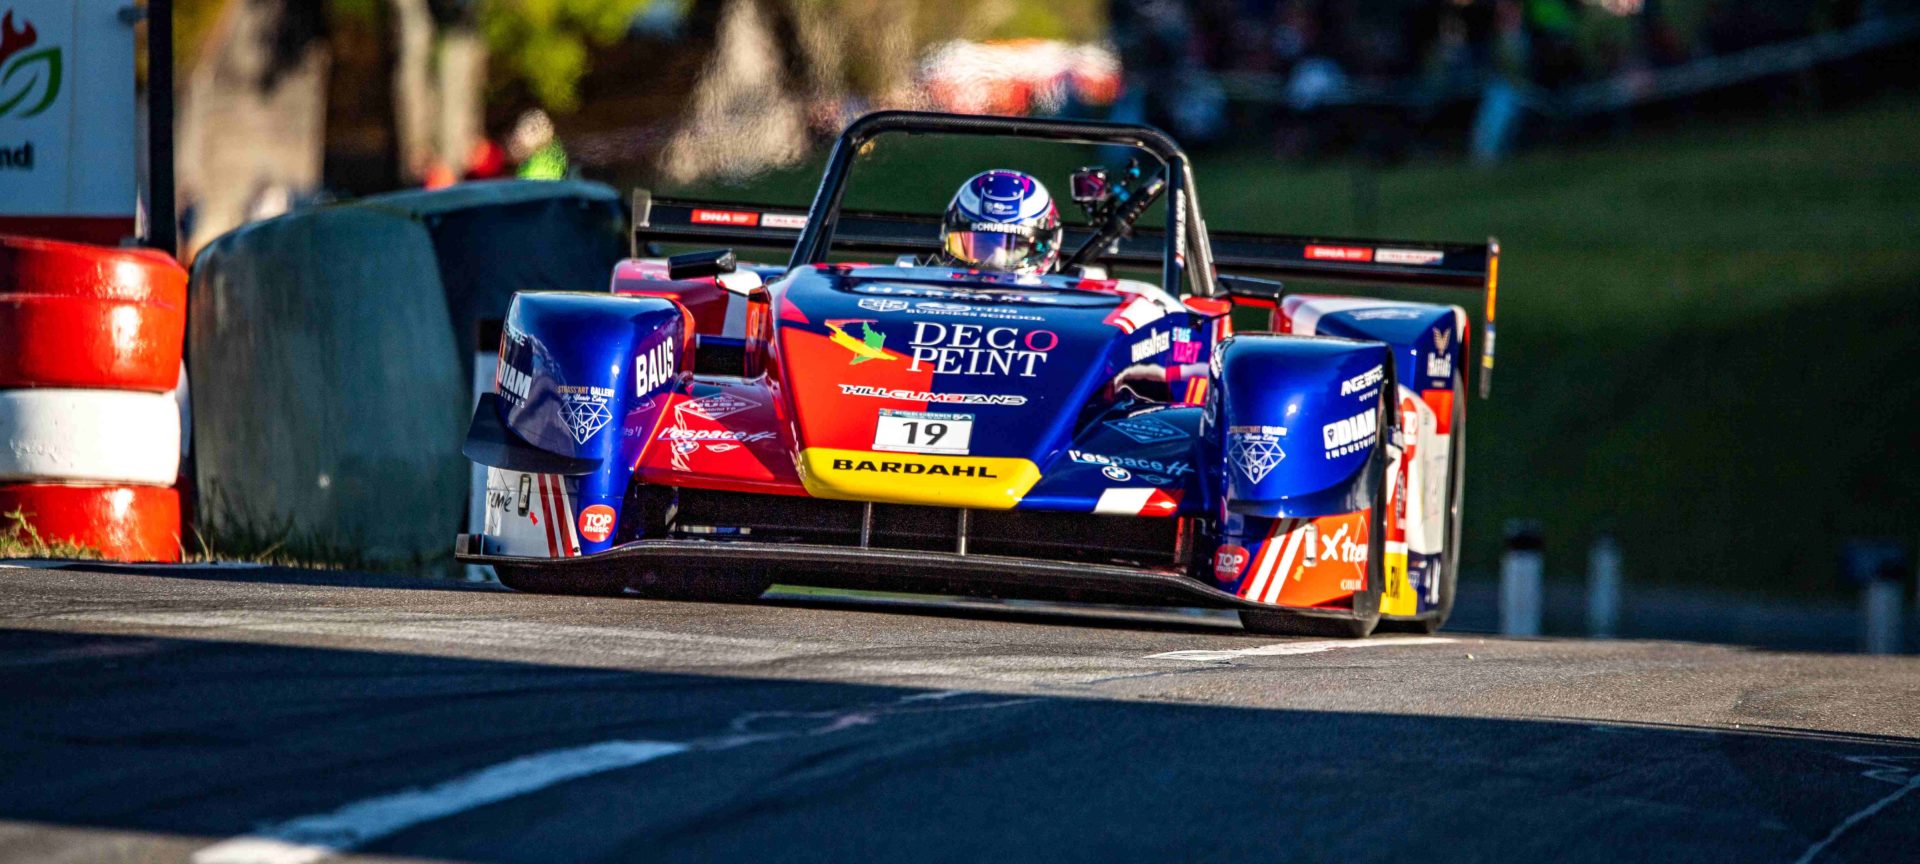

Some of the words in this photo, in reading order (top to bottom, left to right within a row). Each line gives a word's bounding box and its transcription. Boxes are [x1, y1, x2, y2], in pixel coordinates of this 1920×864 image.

[979, 312, 1046, 322] SCHOOL
[908, 321, 1059, 352] DECO
[636, 335, 674, 398] BAUS
[906, 346, 1047, 377] PEINT
[902, 421, 948, 446] 19
[832, 459, 998, 478] BARDAHL
[586, 513, 612, 527] TOP
[584, 525, 609, 534] music
[1218, 552, 1243, 566] TOP
[1216, 564, 1240, 574] music
